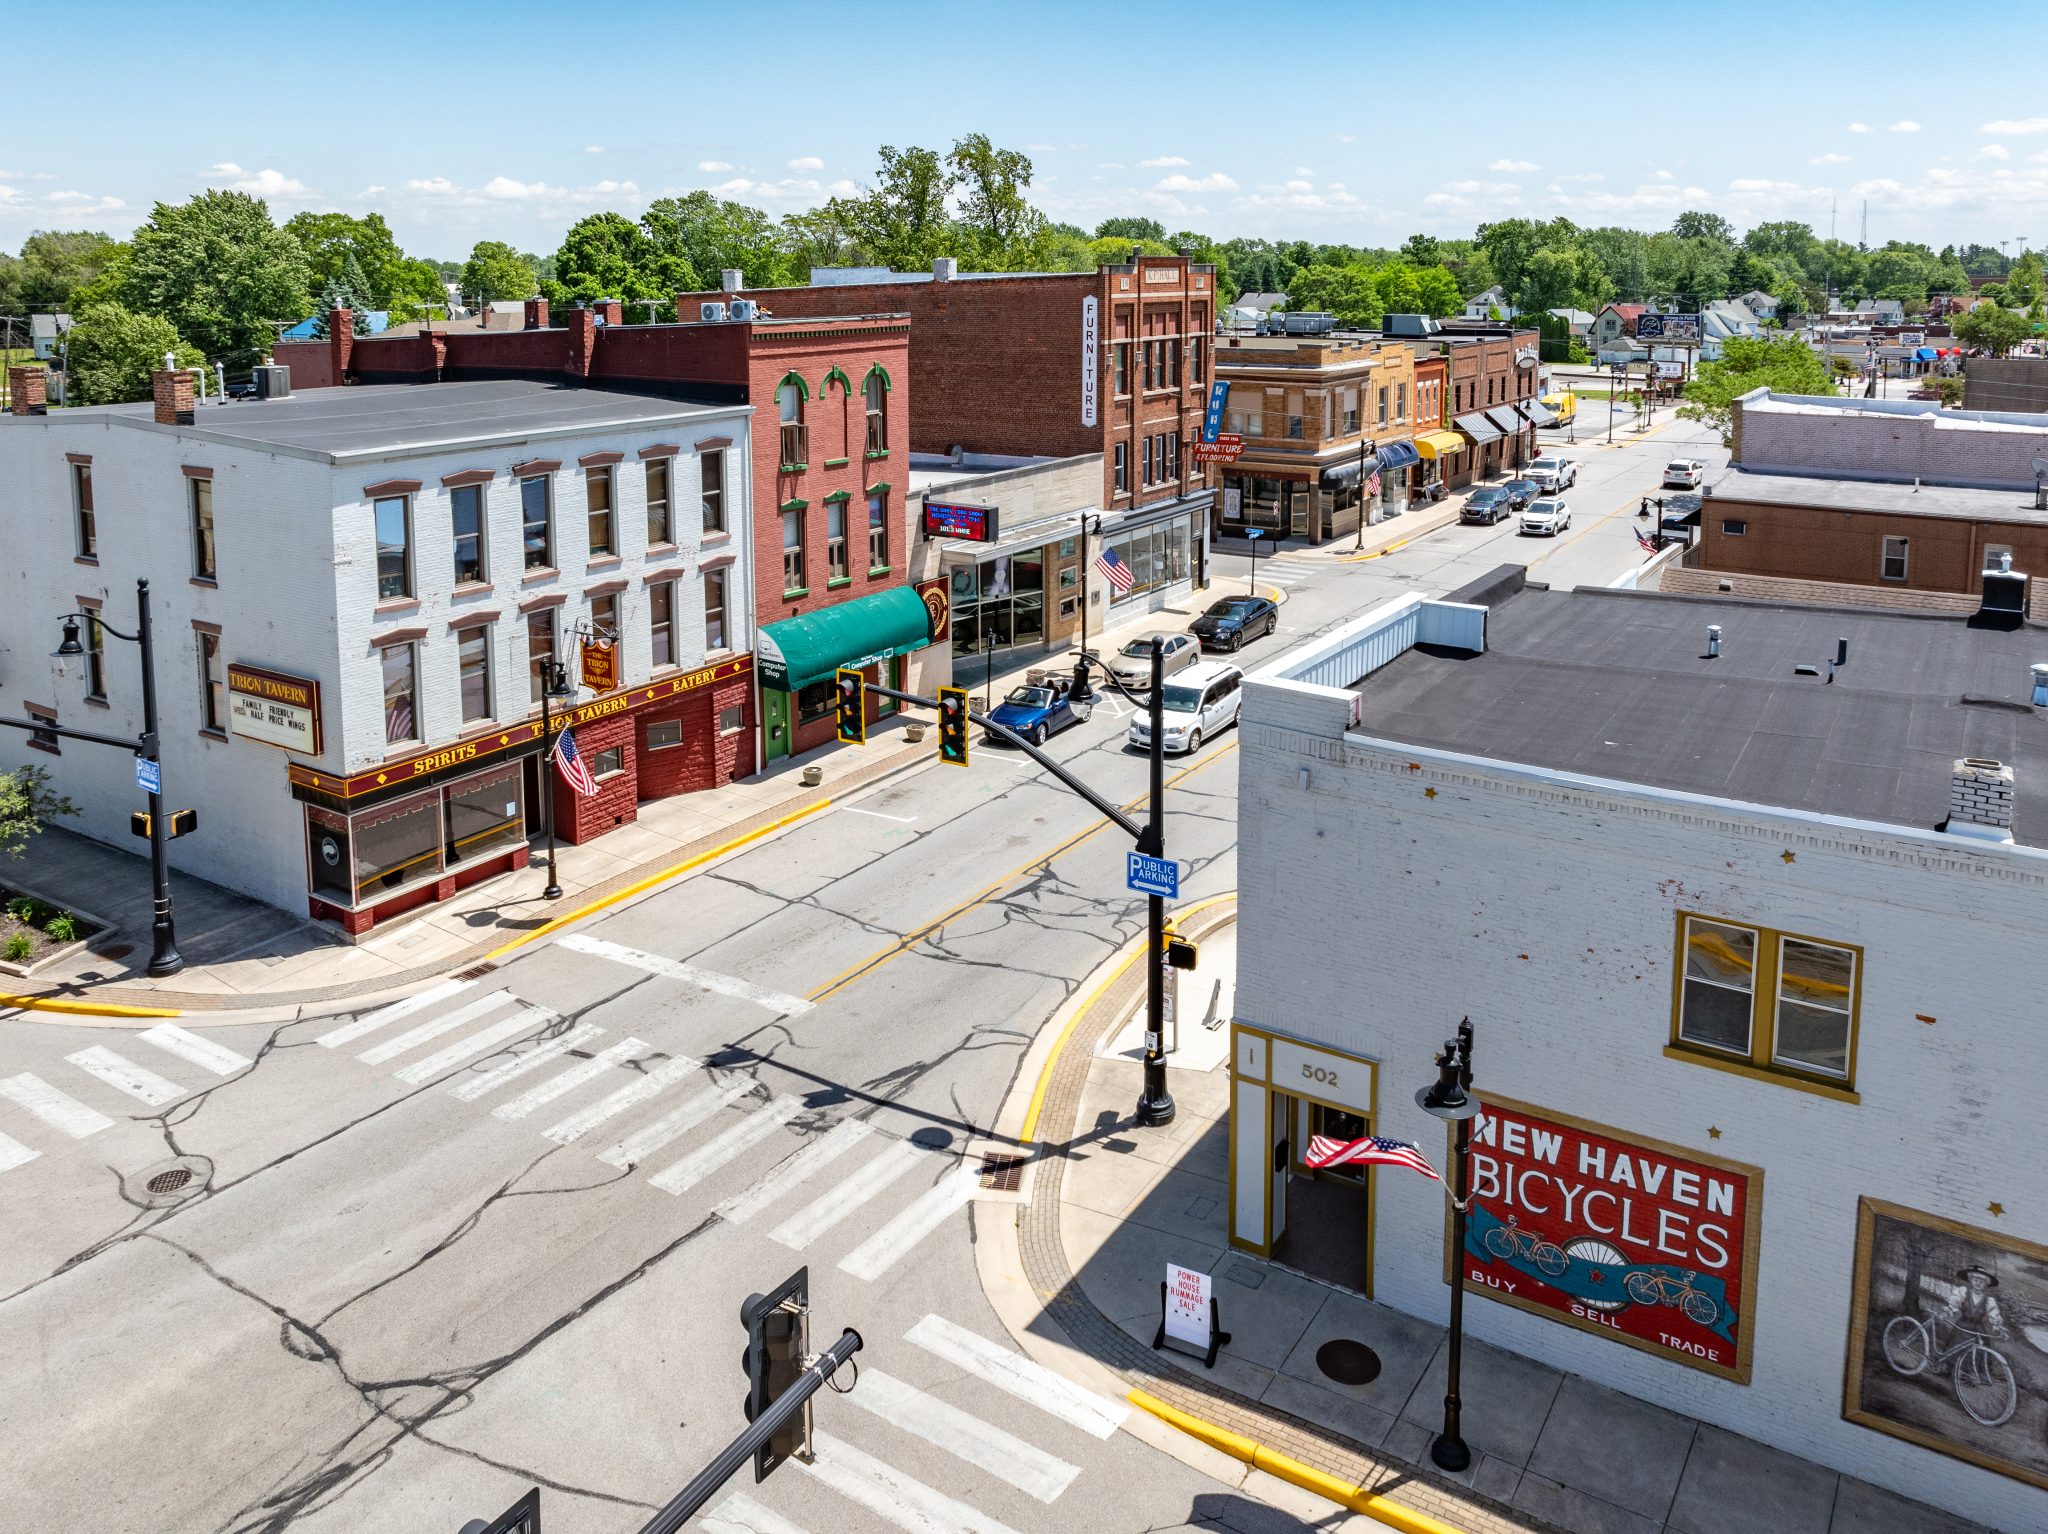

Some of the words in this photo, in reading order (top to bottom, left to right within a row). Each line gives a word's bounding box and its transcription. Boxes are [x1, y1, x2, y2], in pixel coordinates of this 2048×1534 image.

[1085, 304, 1094, 419] FURNITURE
[1207, 386, 1222, 439] RUHL
[1194, 443, 1243, 453] FURNITURE
[1201, 453, 1235, 462] FLOORING
[940, 525, 954, 533] 101.3
[587, 658, 608, 669] TRION
[592, 651, 603, 659] THE
[851, 659, 872, 670] Computer
[871, 655, 883, 663] Shop
[758, 659, 787, 672] Computer
[764, 668, 780, 679] Shop
[230, 673, 261, 691] TRION
[264, 681, 306, 703] TAVERN
[585, 674, 611, 686] TAVERN
[672, 669, 717, 693] EATERY
[243, 699, 262, 710] FAMILY
[269, 706, 294, 718] FRIENDLY
[578, 696, 628, 722] TAVERN
[251, 710, 264, 720] HALF
[268, 714, 284, 726] PRICE
[288, 720, 306, 732] WINGS
[413, 744, 476, 775] SPIRITS
[1130, 855, 1175, 876] PUBLIC
[1302, 1063, 1338, 1087] 502
[1474, 1112, 1563, 1165] NEW
[1578, 1142, 1734, 1216] HAVEN
[1471, 1152, 1729, 1269] BICYCLES
[1178, 1270, 1200, 1284] POWER
[1179, 1280, 1200, 1294] HOUSE
[1472, 1270, 1517, 1294] BUY
[1171, 1287, 1203, 1304] RUMMAGE
[1180, 1300, 1195, 1311] SALE
[1570, 1303, 1621, 1329] SELL
[1659, 1332, 1719, 1362] TRADE
